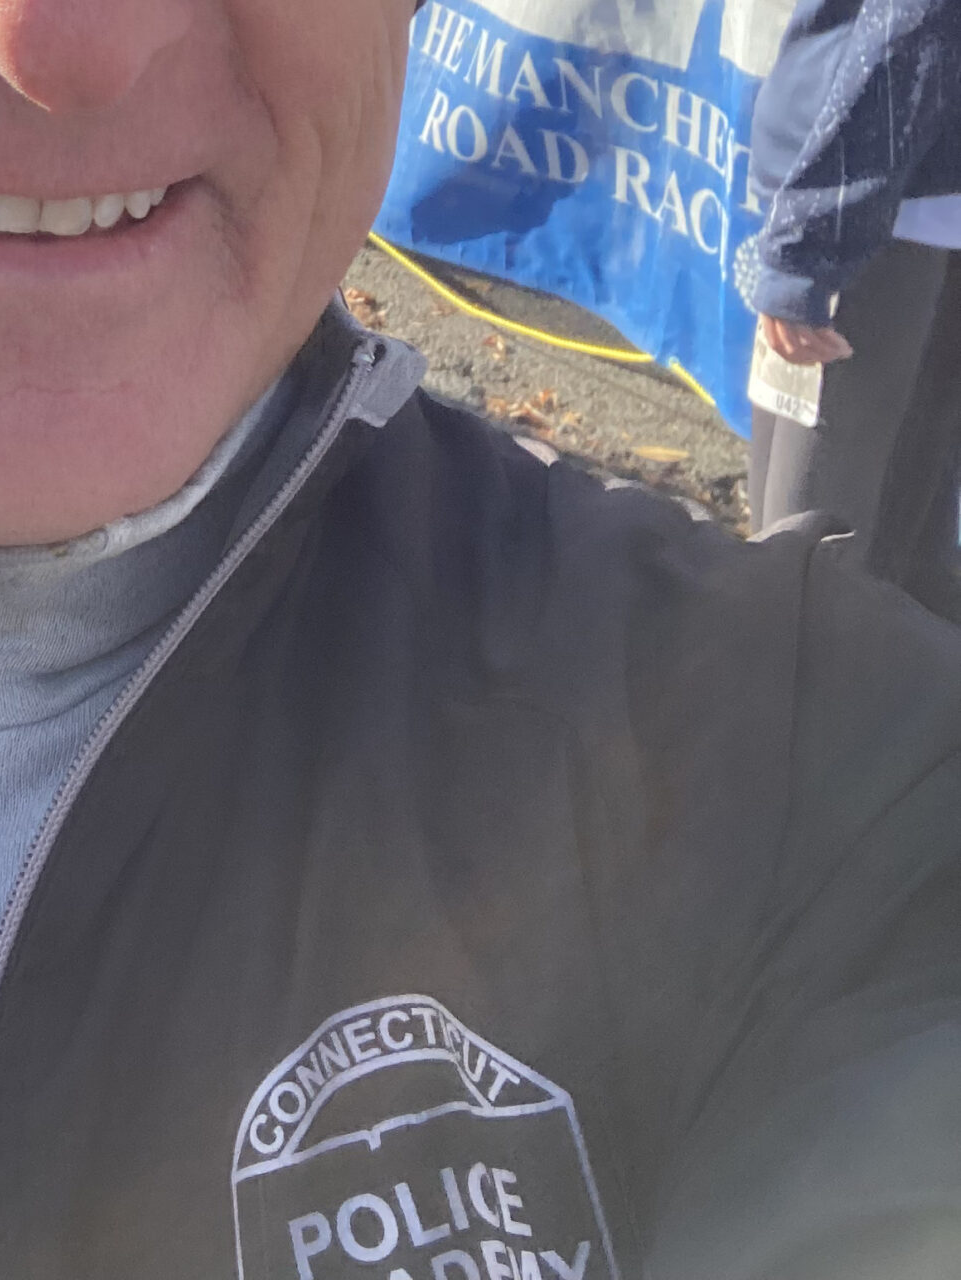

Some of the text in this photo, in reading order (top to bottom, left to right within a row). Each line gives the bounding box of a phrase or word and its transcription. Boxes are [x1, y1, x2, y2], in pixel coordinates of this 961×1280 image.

[409, 1, 475, 74] HE
[419, 88, 728, 260] ROAD RAC
[249, 1008, 520, 1154] CONNECTICUT
[289, 1162, 532, 1280] POLICE
